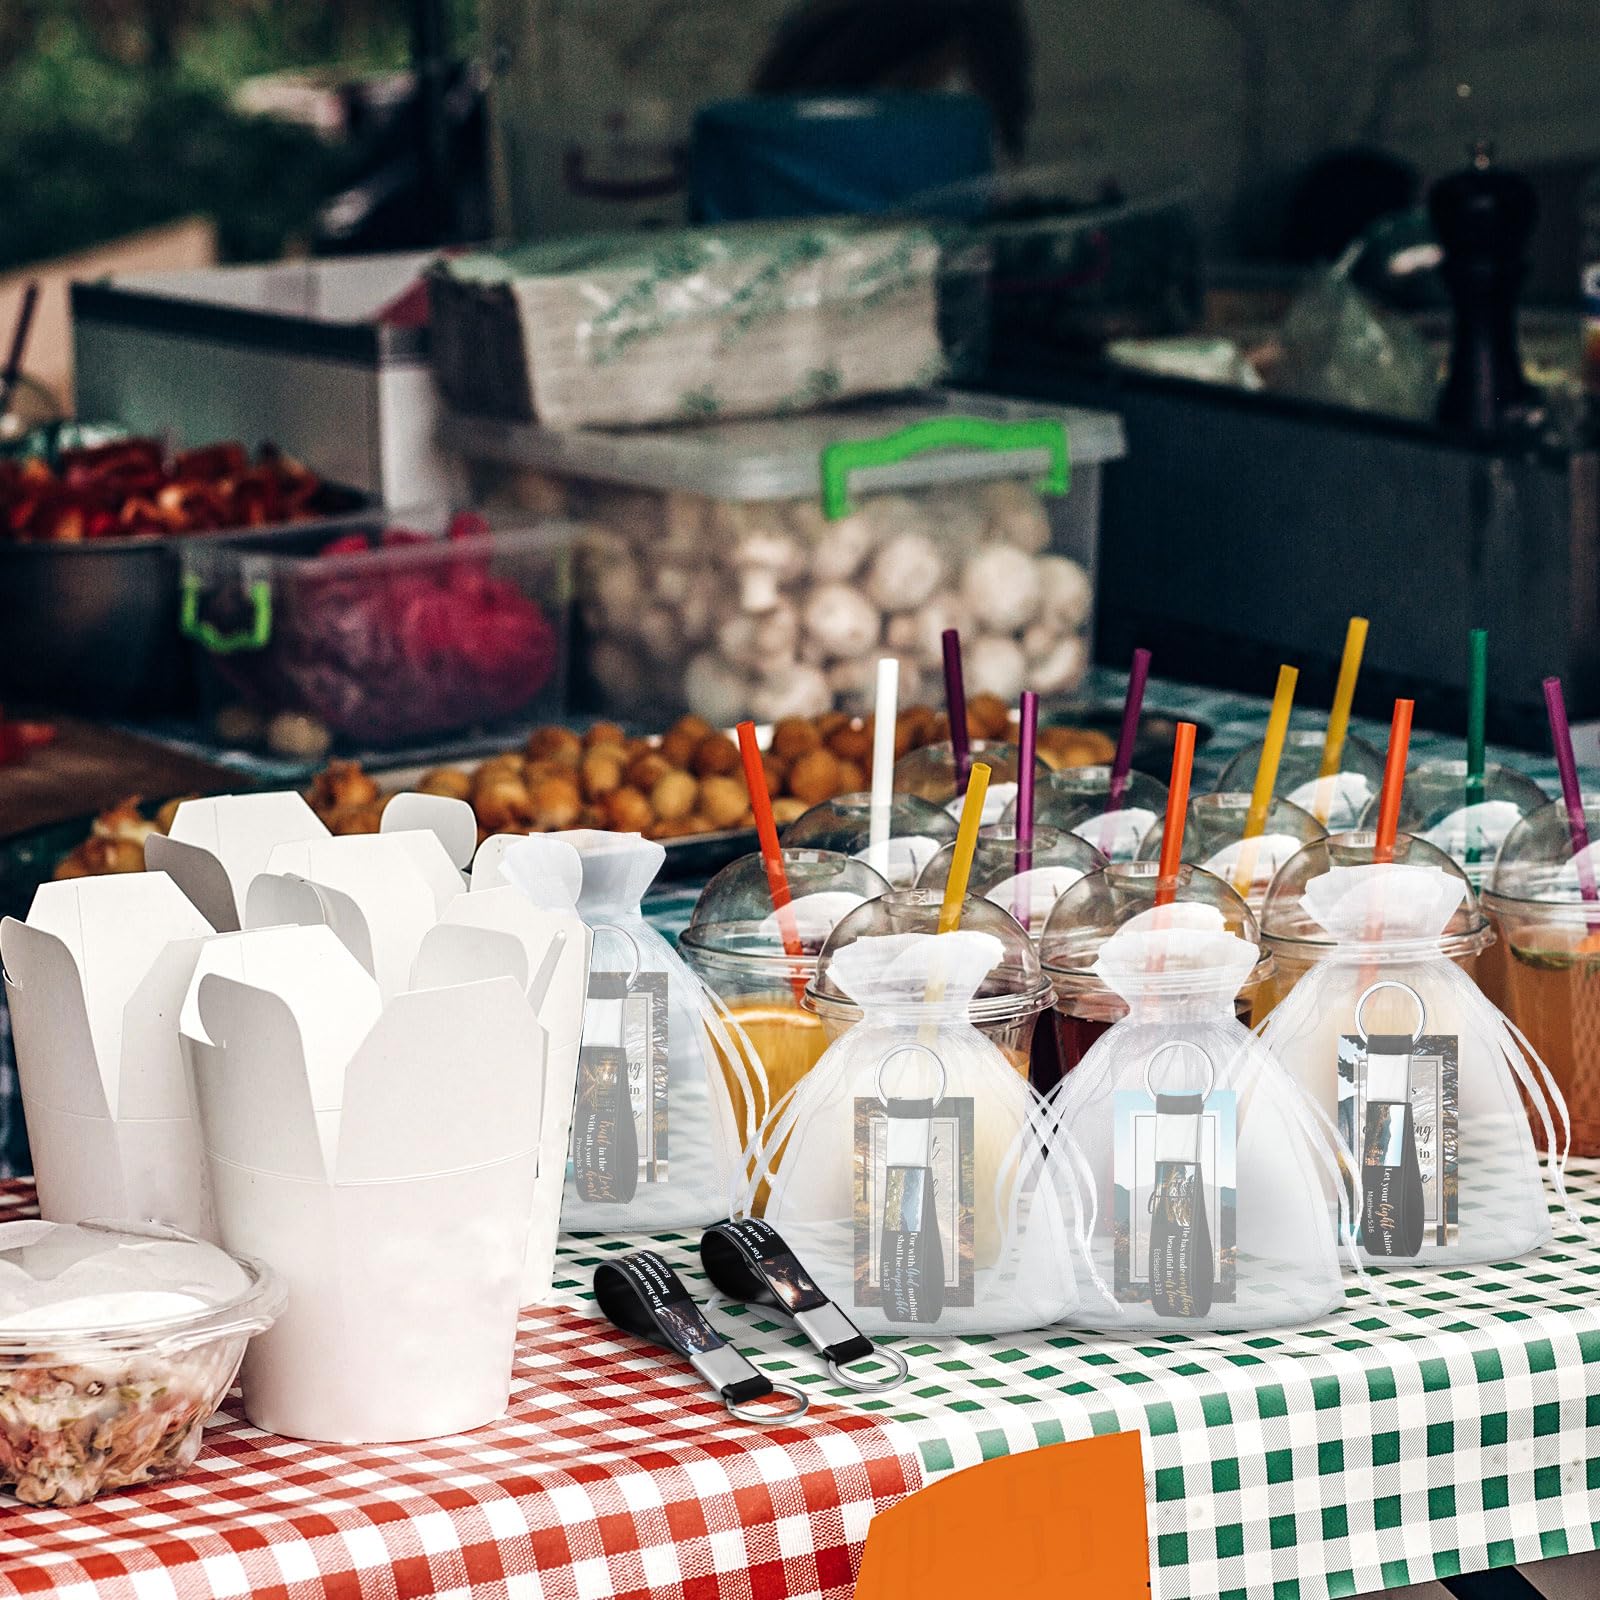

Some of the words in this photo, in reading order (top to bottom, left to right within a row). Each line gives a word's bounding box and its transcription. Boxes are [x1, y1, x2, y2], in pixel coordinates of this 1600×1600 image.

[586, 1134, 594, 1146] all
[584, 1146, 593, 1168] your
[599, 1147, 607, 1155] in
[599, 1157, 608, 1172] the
[1384, 1168, 1393, 1181] Let
[1380, 1182, 1390, 1203] your
[1375, 1203, 1395, 1229] light
[752, 1231, 765, 1241] not
[909, 1232, 918, 1246] For
[1182, 1226, 1191, 1238] He
[742, 1236, 752, 1245] we
[896, 1234, 904, 1255] shall
[1180, 1238, 1189, 1252] has
[1383, 1230, 1393, 1256] shine.
[750, 1246, 762, 1258] For
[907, 1248, 916, 1267] with
[1166, 1235, 1176, 1269] beautiful
[896, 1257, 904, 1268] be
[1179, 1252, 1188, 1273] made
[628, 1263, 646, 1280] made
[641, 1262, 669, 1294] beautiful
[1167, 1270, 1174, 1278] in
[643, 1280, 655, 1294] has
[652, 1294, 663, 1306] He
[908, 1287, 919, 1321] nothing
